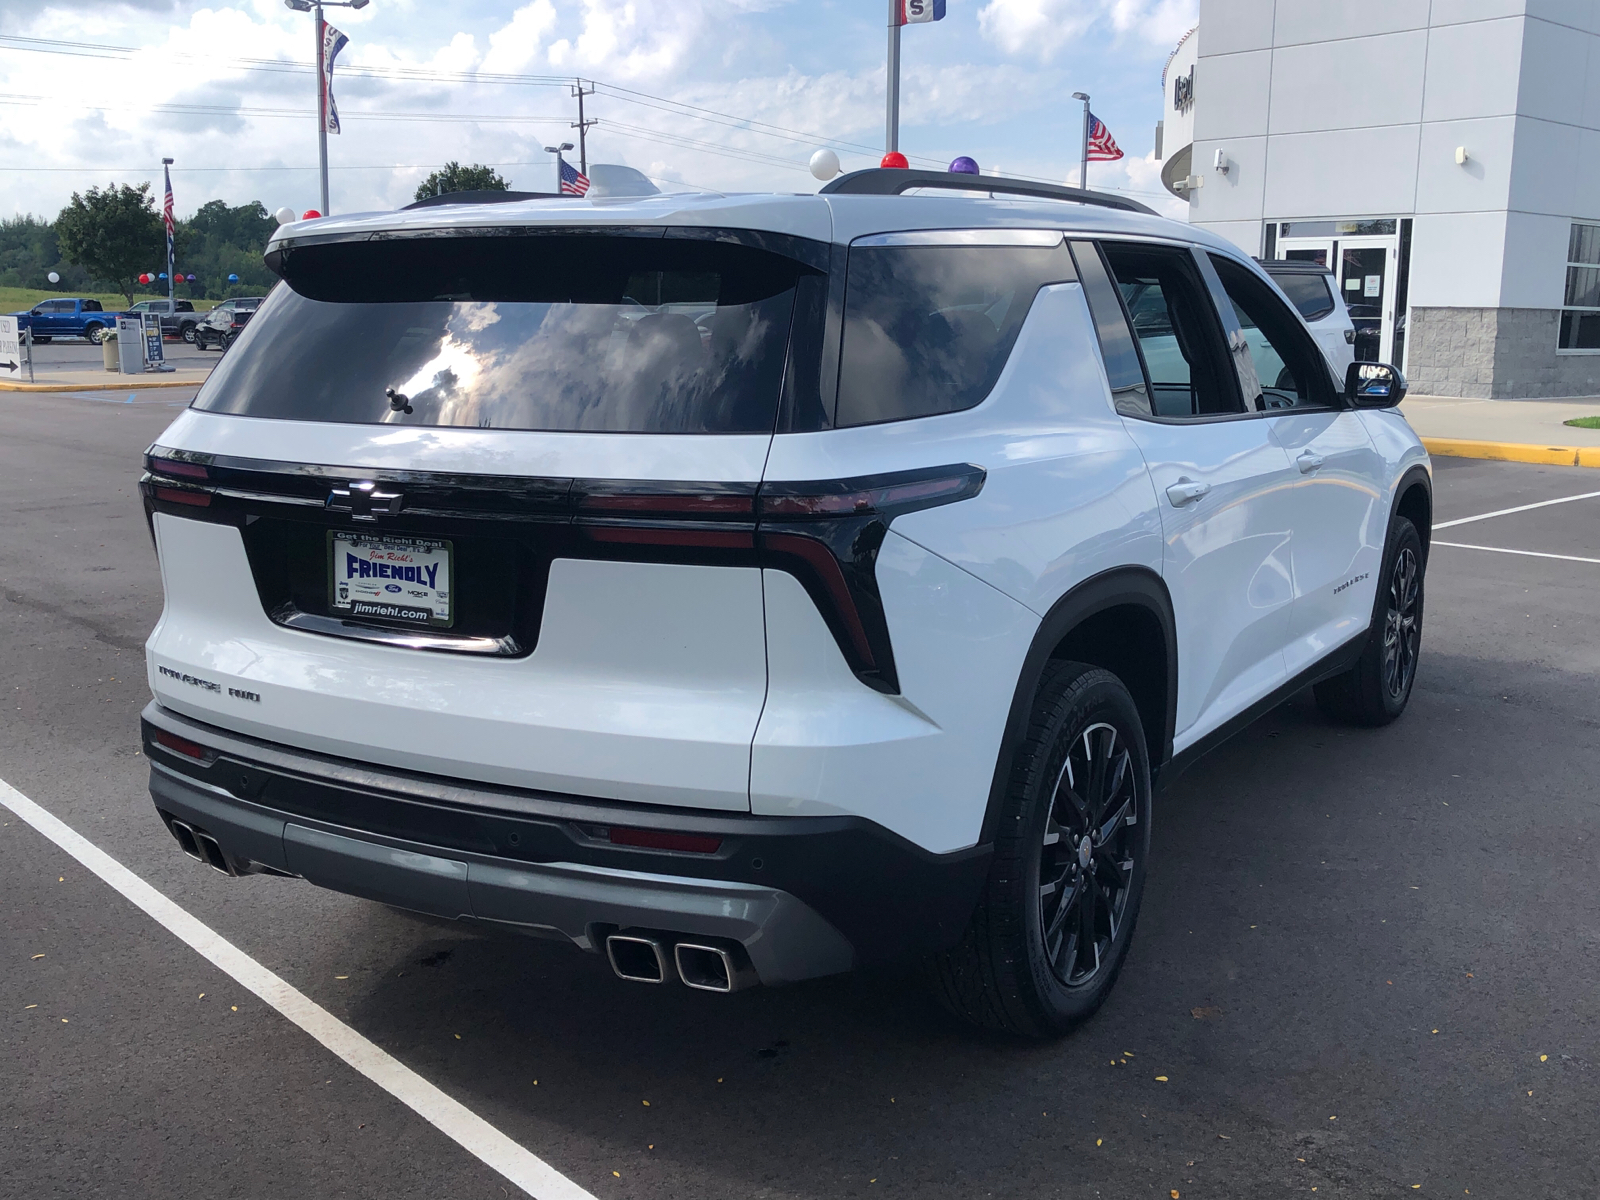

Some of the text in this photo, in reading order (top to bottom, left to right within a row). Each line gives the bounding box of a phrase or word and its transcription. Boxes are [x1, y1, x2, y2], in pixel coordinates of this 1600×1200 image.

[336, 532, 443, 548] Get the Riehl Deal
[369, 550, 414, 563] Jim Riehl's
[347, 552, 439, 590] FRIENDLY
[354, 603, 427, 620] jimriehl.com
[158, 665, 221, 693] TRAVERSE
